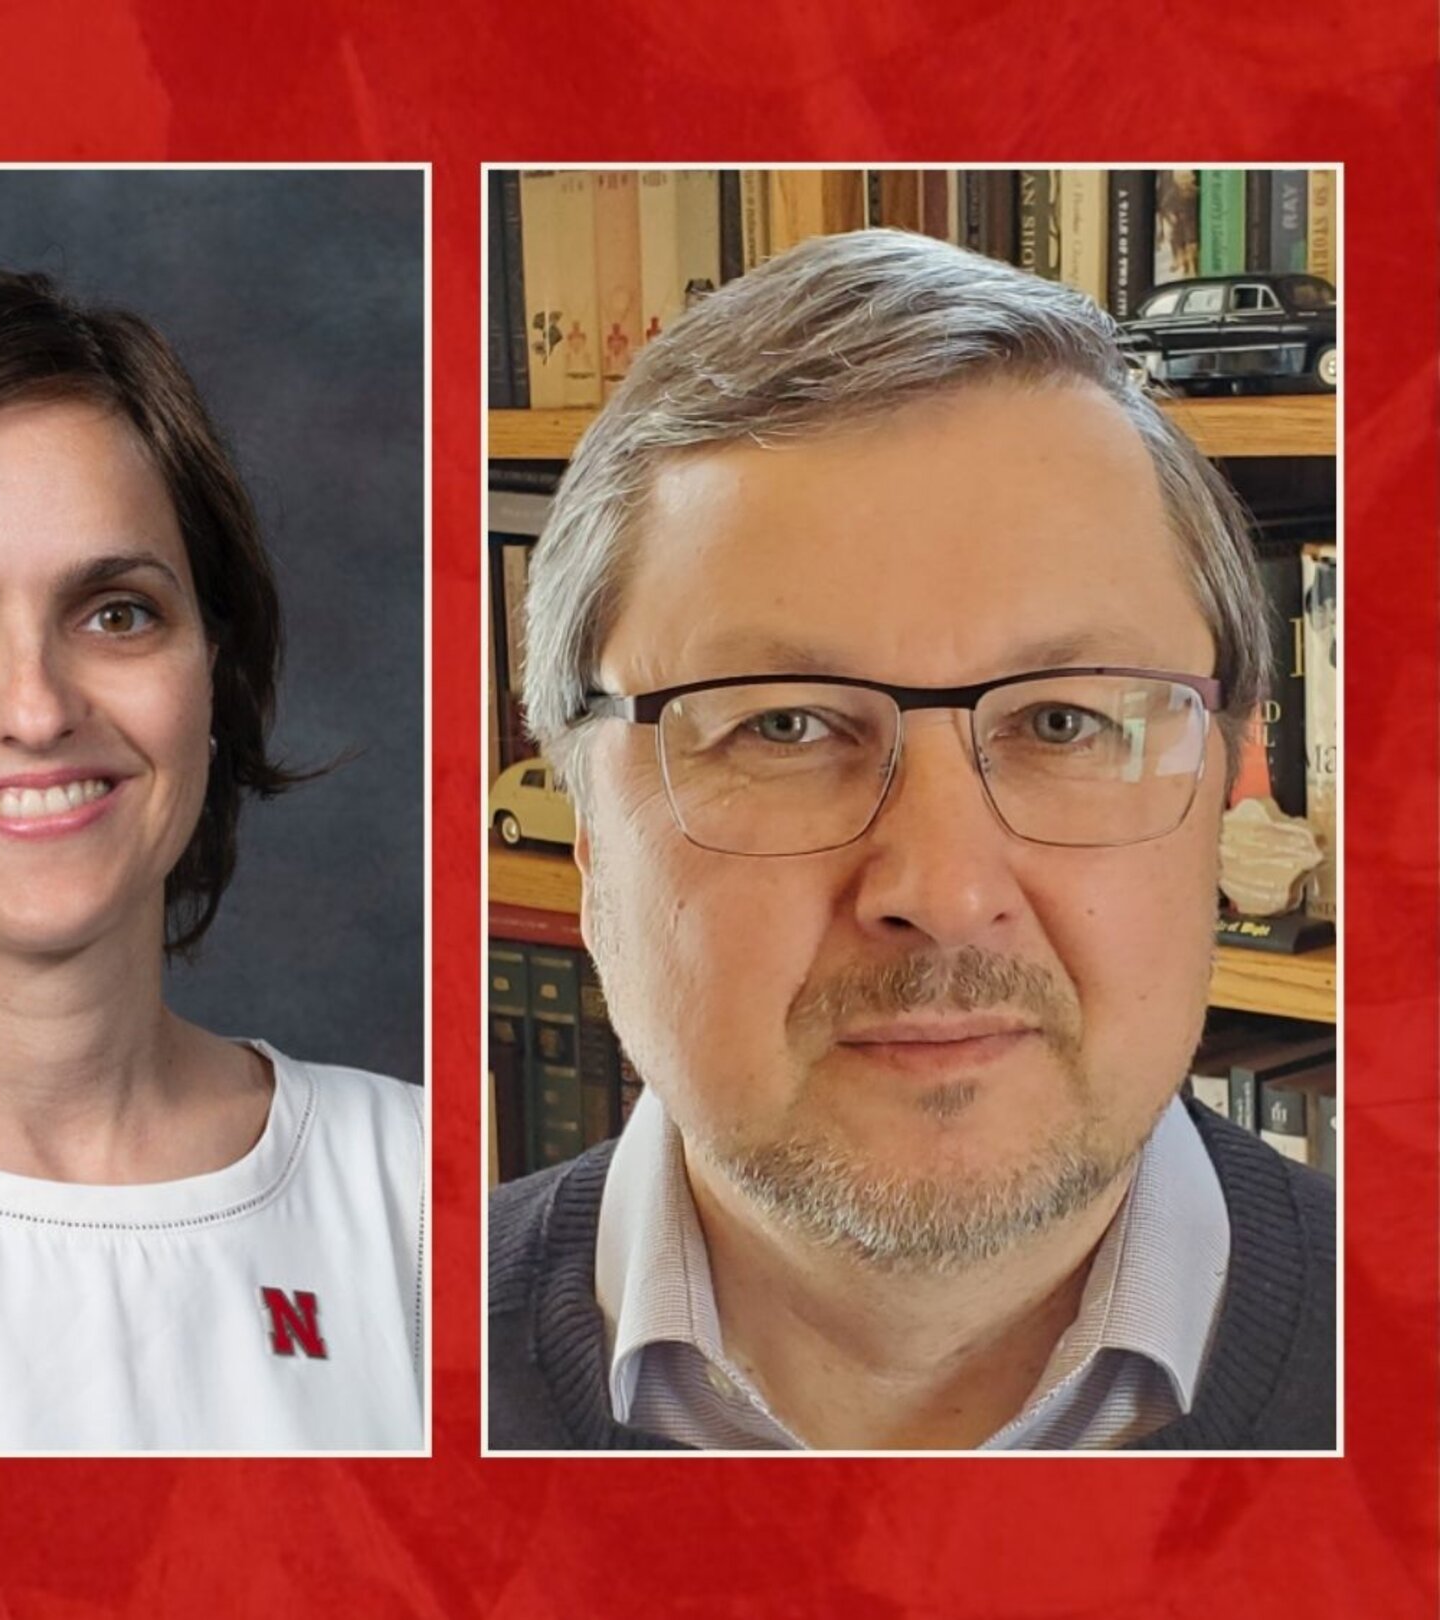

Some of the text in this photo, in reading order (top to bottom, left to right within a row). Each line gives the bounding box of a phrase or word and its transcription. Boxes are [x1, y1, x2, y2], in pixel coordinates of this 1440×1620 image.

[1118, 189, 1130, 199] A
[1118, 200, 1130, 235] TALE
[1118, 237, 1130, 255] OF
[1118, 256, 1130, 287] TWO
[259, 1285, 329, 1361] N
